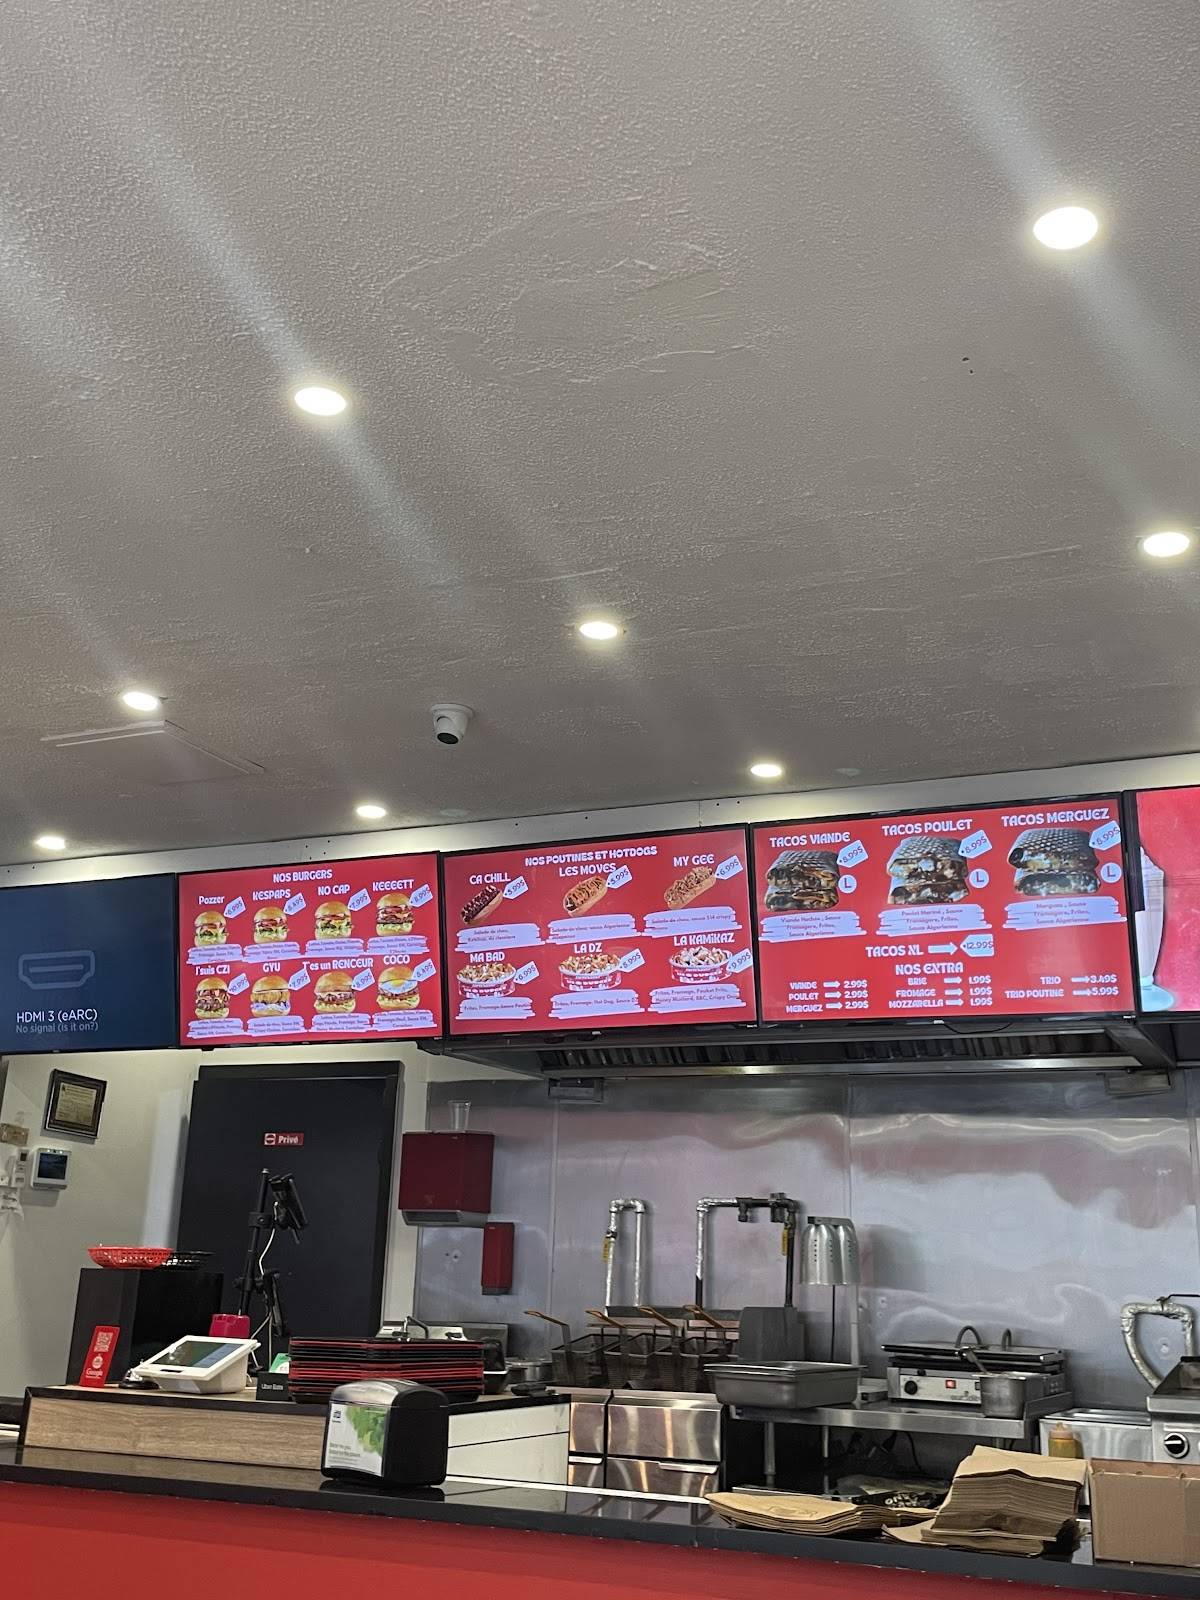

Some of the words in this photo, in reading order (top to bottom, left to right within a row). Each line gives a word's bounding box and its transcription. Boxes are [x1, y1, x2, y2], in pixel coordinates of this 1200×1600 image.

[1001, 814, 1045, 827] TACOS
[1047, 808, 1110, 823] MERGUEZ
[882, 824, 922, 836] TACOS
[924, 819, 973, 832] POULET
[769, 836, 808, 848] TACOS
[810, 832, 851, 844] VIANDE
[525, 857, 545, 866] NOS
[546, 852, 594, 864] POUTINES
[594, 850, 608, 860] ET
[609, 846, 658, 859] HOTDOGS
[673, 856, 690, 867] MY
[692, 854, 715, 866] GEE
[559, 866, 578, 877] LES
[580, 862, 617, 875] MOVES
[1106, 866, 1116, 878] L
[273, 873, 292, 883] NOS
[292, 869, 332, 882] BURGERS
[470, 874, 483, 885] CA
[484, 872, 511, 884] CHILL
[976, 872, 984, 882] L
[844, 878, 852, 888] L
[318, 886, 331, 896] NO
[332, 884, 350, 894] CAP
[673, 936, 688, 946] LA
[574, 943, 587, 954] LA
[588, 942, 603, 953] DZ
[866, 946, 906, 958] TACOS
[384, 954, 410, 965] COCO
[470, 953, 485, 963] MA
[486, 951, 505, 962] BAD
[262, 962, 280, 973] GYU
[320, 962, 331, 970] un
[896, 964, 921, 975] NOS
[923, 962, 964, 974] EXTRA
[790, 981, 817, 990] VIANDE
[844, 980, 868, 988] 2.99$
[1040, 976, 1061, 984] TRIO
[788, 992, 819, 1000] POULET
[844, 990, 868, 999] 2.99$
[896, 989, 936, 998] FROMAGE
[1005, 990, 1025, 998] TRIO
[1026, 989, 1064, 998] POUTINE
[786, 1004, 823, 1013] MERGUEZ
[845, 1000, 869, 1009] 2.99$
[888, 999, 944, 1008] MOZZARELLA
[16, 1011, 45, 1023] HDMI
[48, 1010, 54, 1021] 3
[57, 1008, 98, 1022] (eARC)
[16, 1025, 28, 1033] No
[31, 1023, 55, 1034] signal
[57, 1023, 68, 1032] (is
[70, 1022, 76, 1031] it
[79, 1022, 98, 1031] on?)
